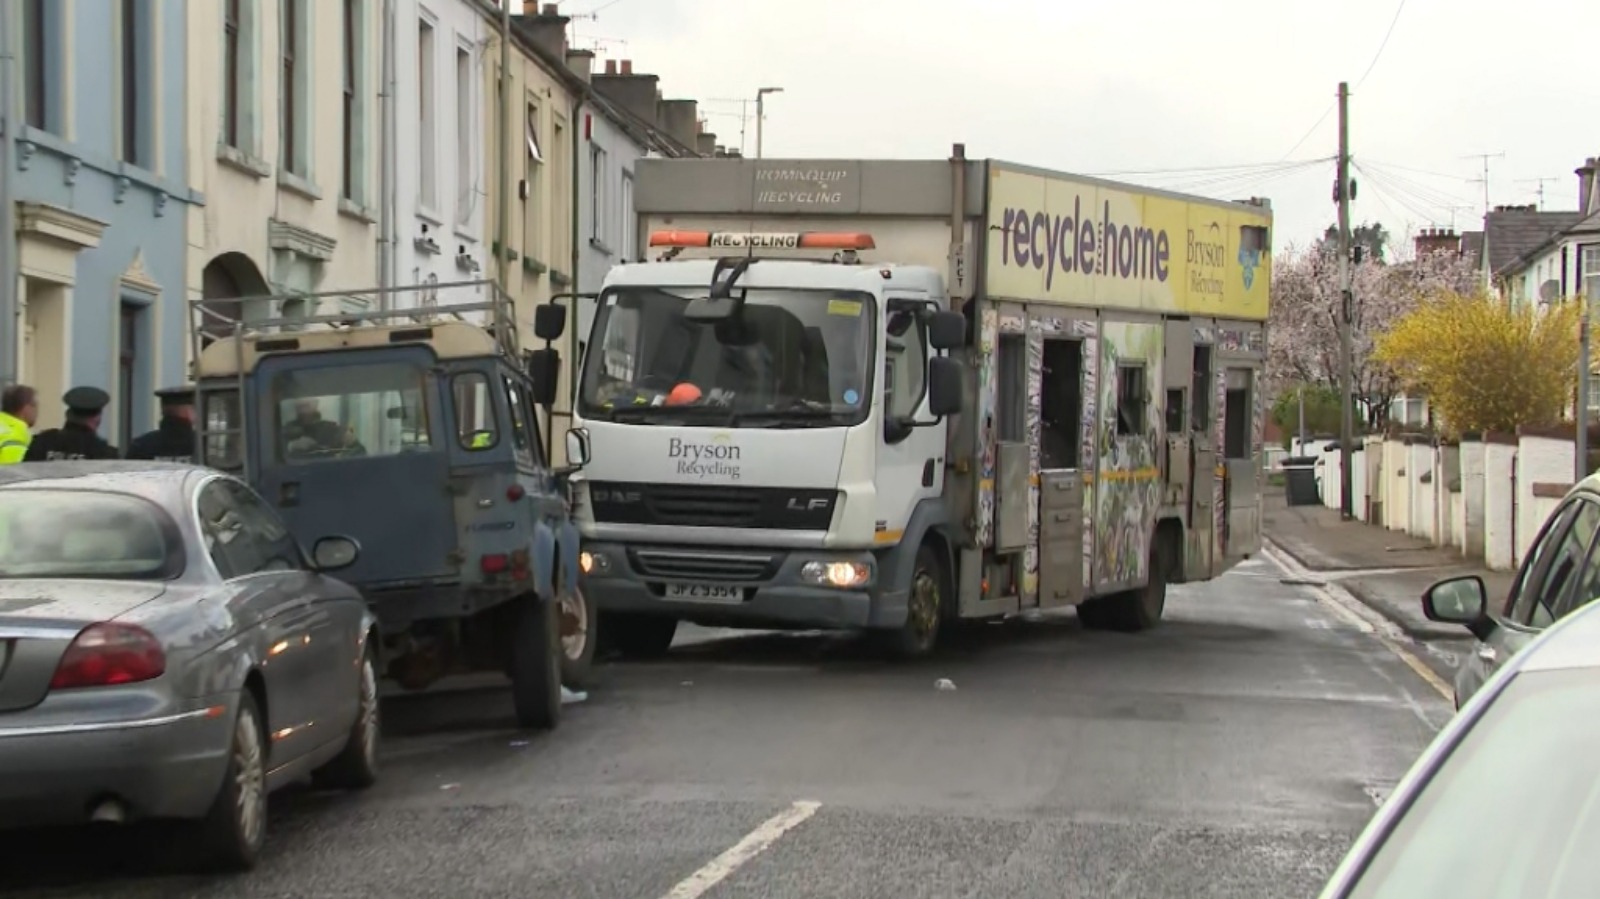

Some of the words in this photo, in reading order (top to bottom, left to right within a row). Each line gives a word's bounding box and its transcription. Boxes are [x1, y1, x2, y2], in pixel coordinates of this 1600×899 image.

[713, 234, 796, 248] RECYCLING
[1001, 194, 1095, 292] recycle
[1103, 199, 1169, 283] home
[1187, 228, 1225, 268] Bryson
[1190, 270, 1224, 302] Recycling
[668, 437, 741, 462] Bryson
[676, 460, 741, 479] Recycling
[786, 498, 829, 511] LF
